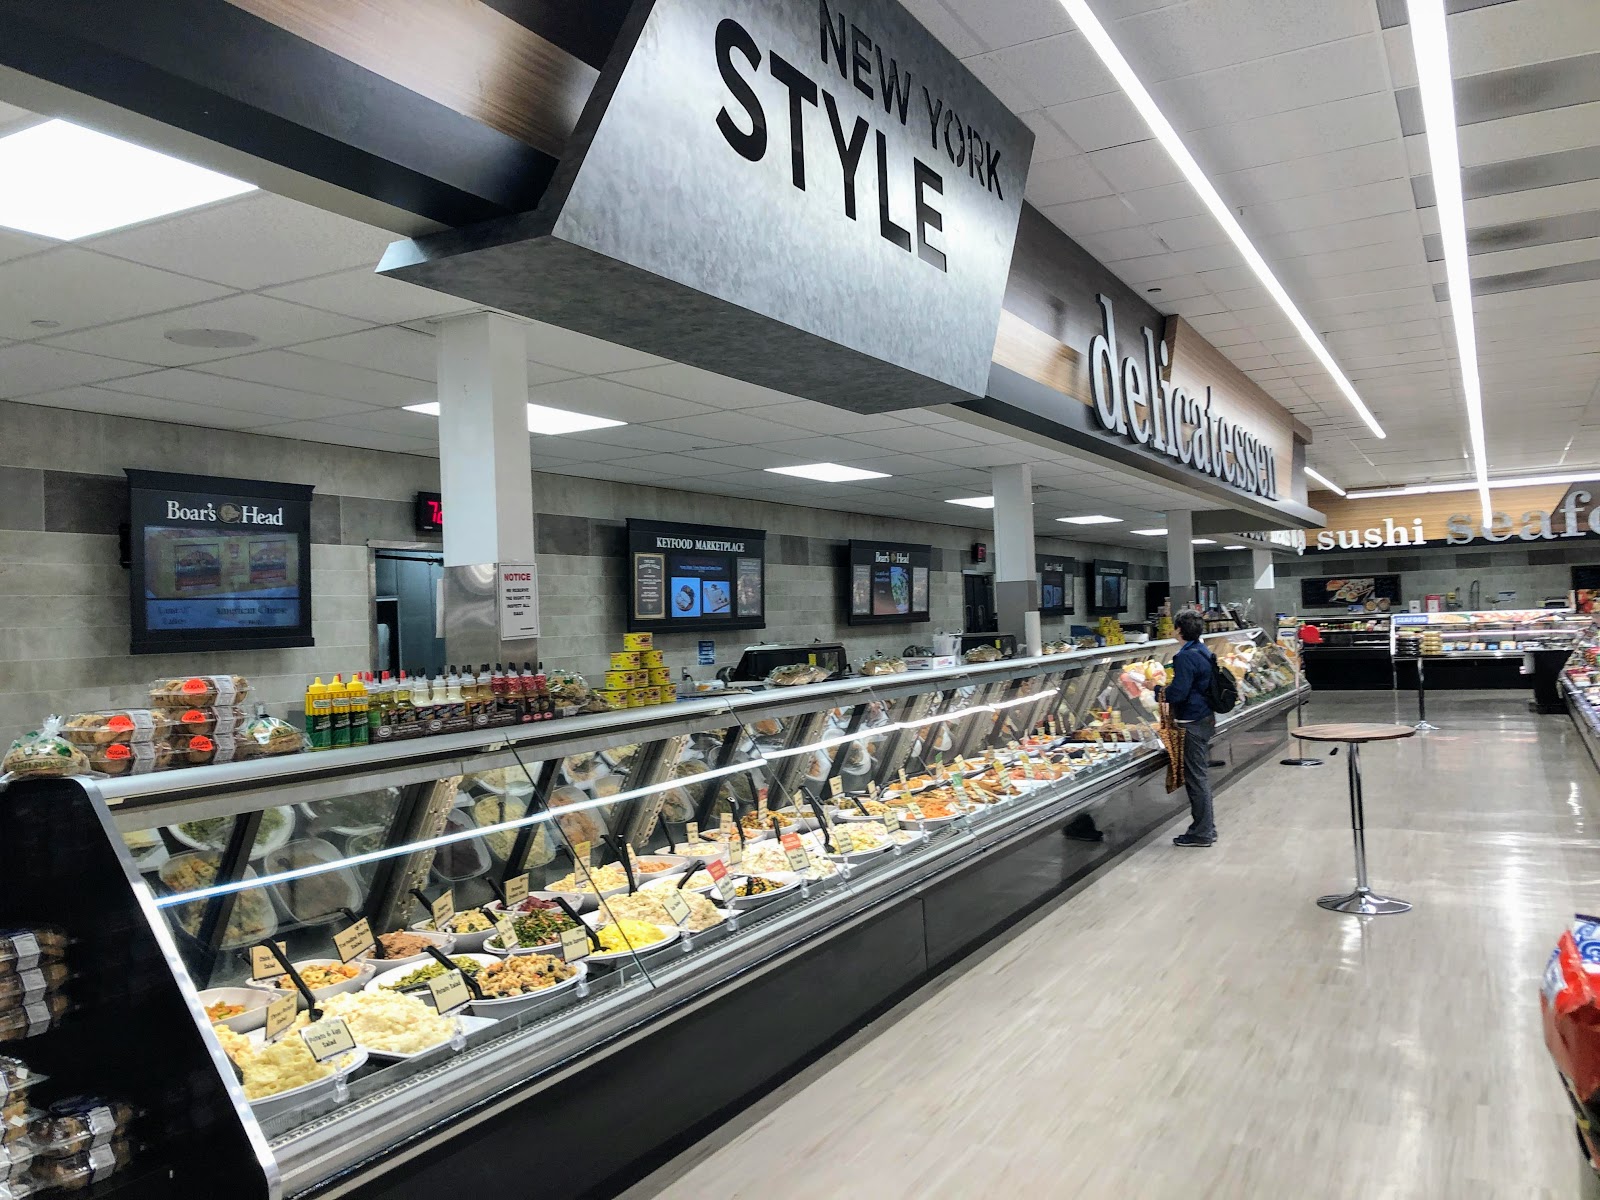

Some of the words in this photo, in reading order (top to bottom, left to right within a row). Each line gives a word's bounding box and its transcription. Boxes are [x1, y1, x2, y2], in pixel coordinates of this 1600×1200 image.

[820, 0, 911, 125] NEW
[922, 86, 1003, 200] YORK
[715, 18, 947, 273] STYLE
[1089, 293, 1279, 500] delicatessen
[166, 500, 216, 521] Boar's
[241, 506, 283, 526] Head
[656, 537, 693, 549] KEYFOOD
[695, 540, 745, 552] MARKETPLACE
[1317, 518, 1427, 551] sushi
[503, 573, 531, 581] NOTICE
